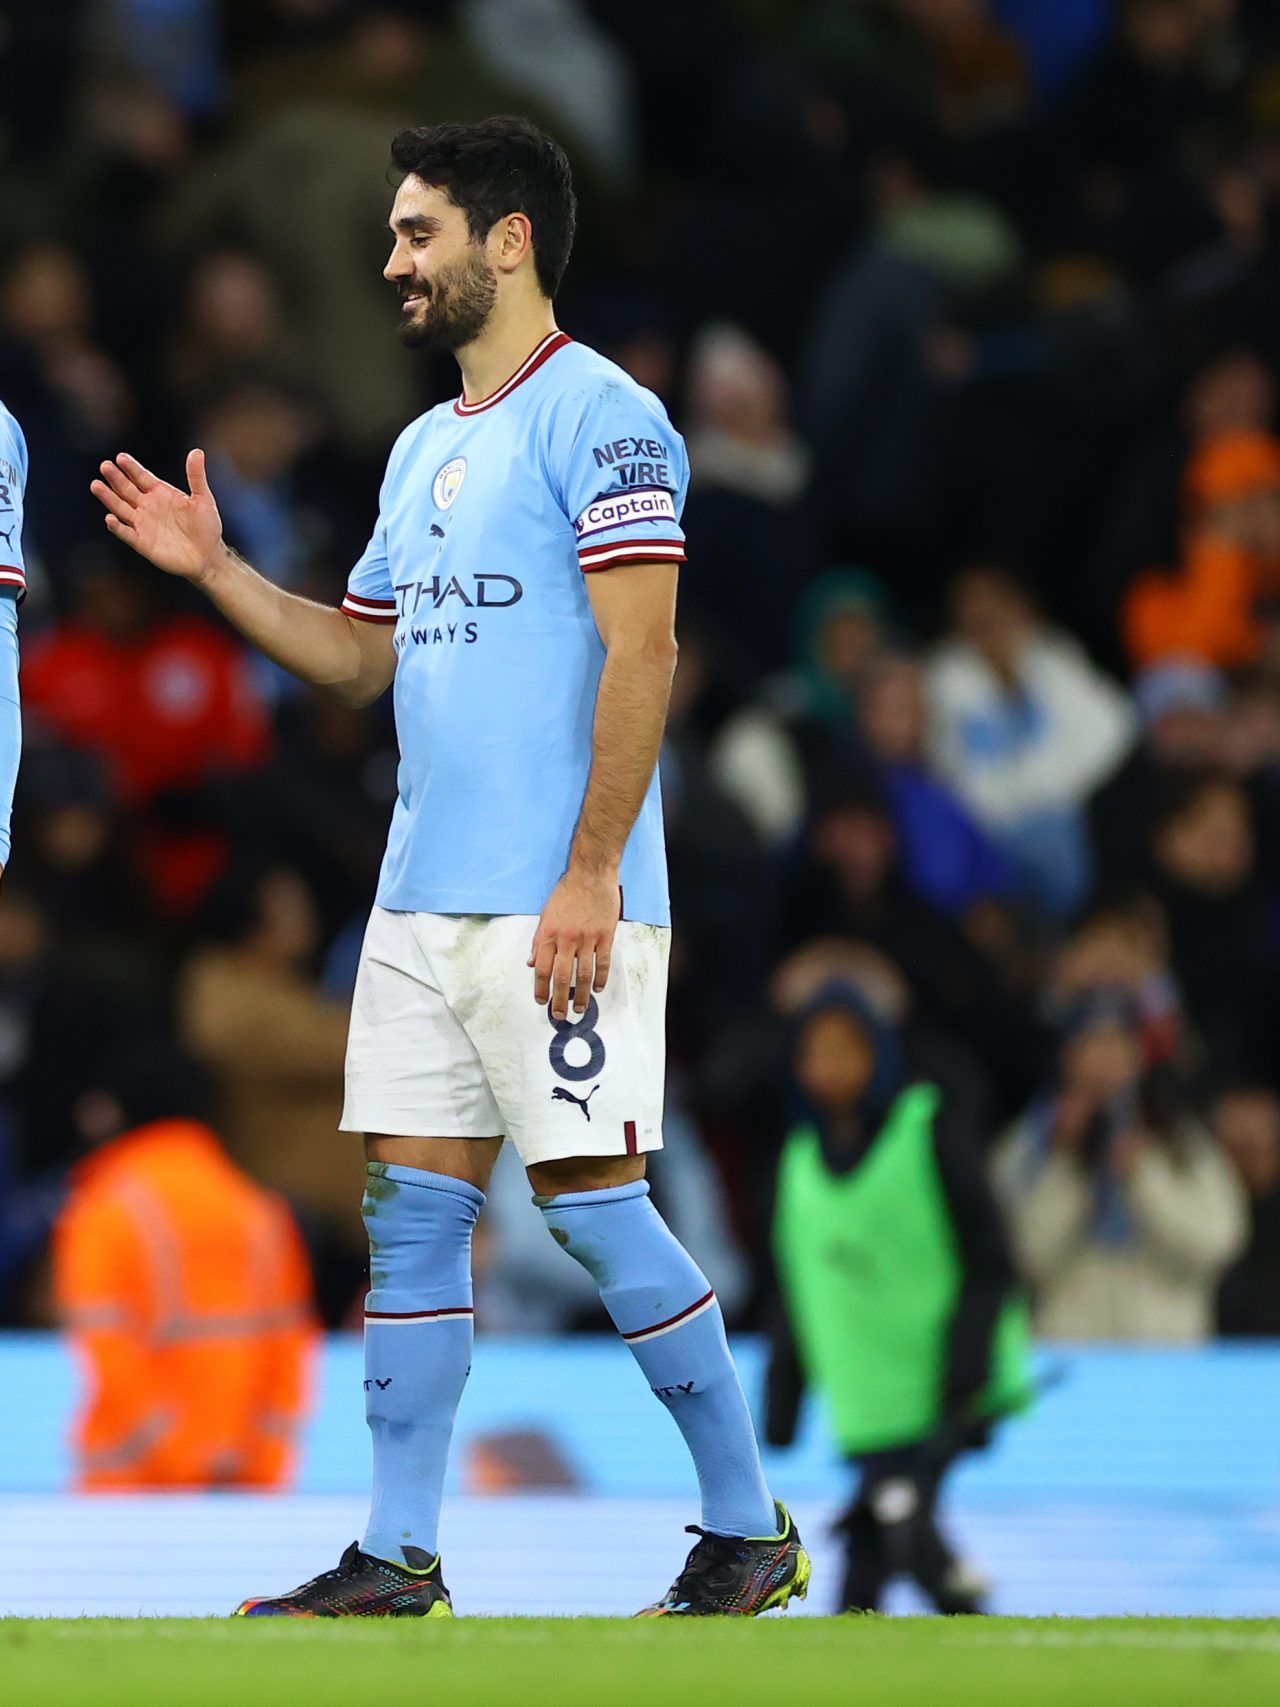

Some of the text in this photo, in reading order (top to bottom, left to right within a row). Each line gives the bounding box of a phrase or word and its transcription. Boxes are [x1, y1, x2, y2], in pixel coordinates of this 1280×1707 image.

[612, 462, 669, 486] TIRE
[588, 494, 670, 523] Captain
[547, 986, 606, 1082] 8
[378, 1566, 400, 1581] COPA
